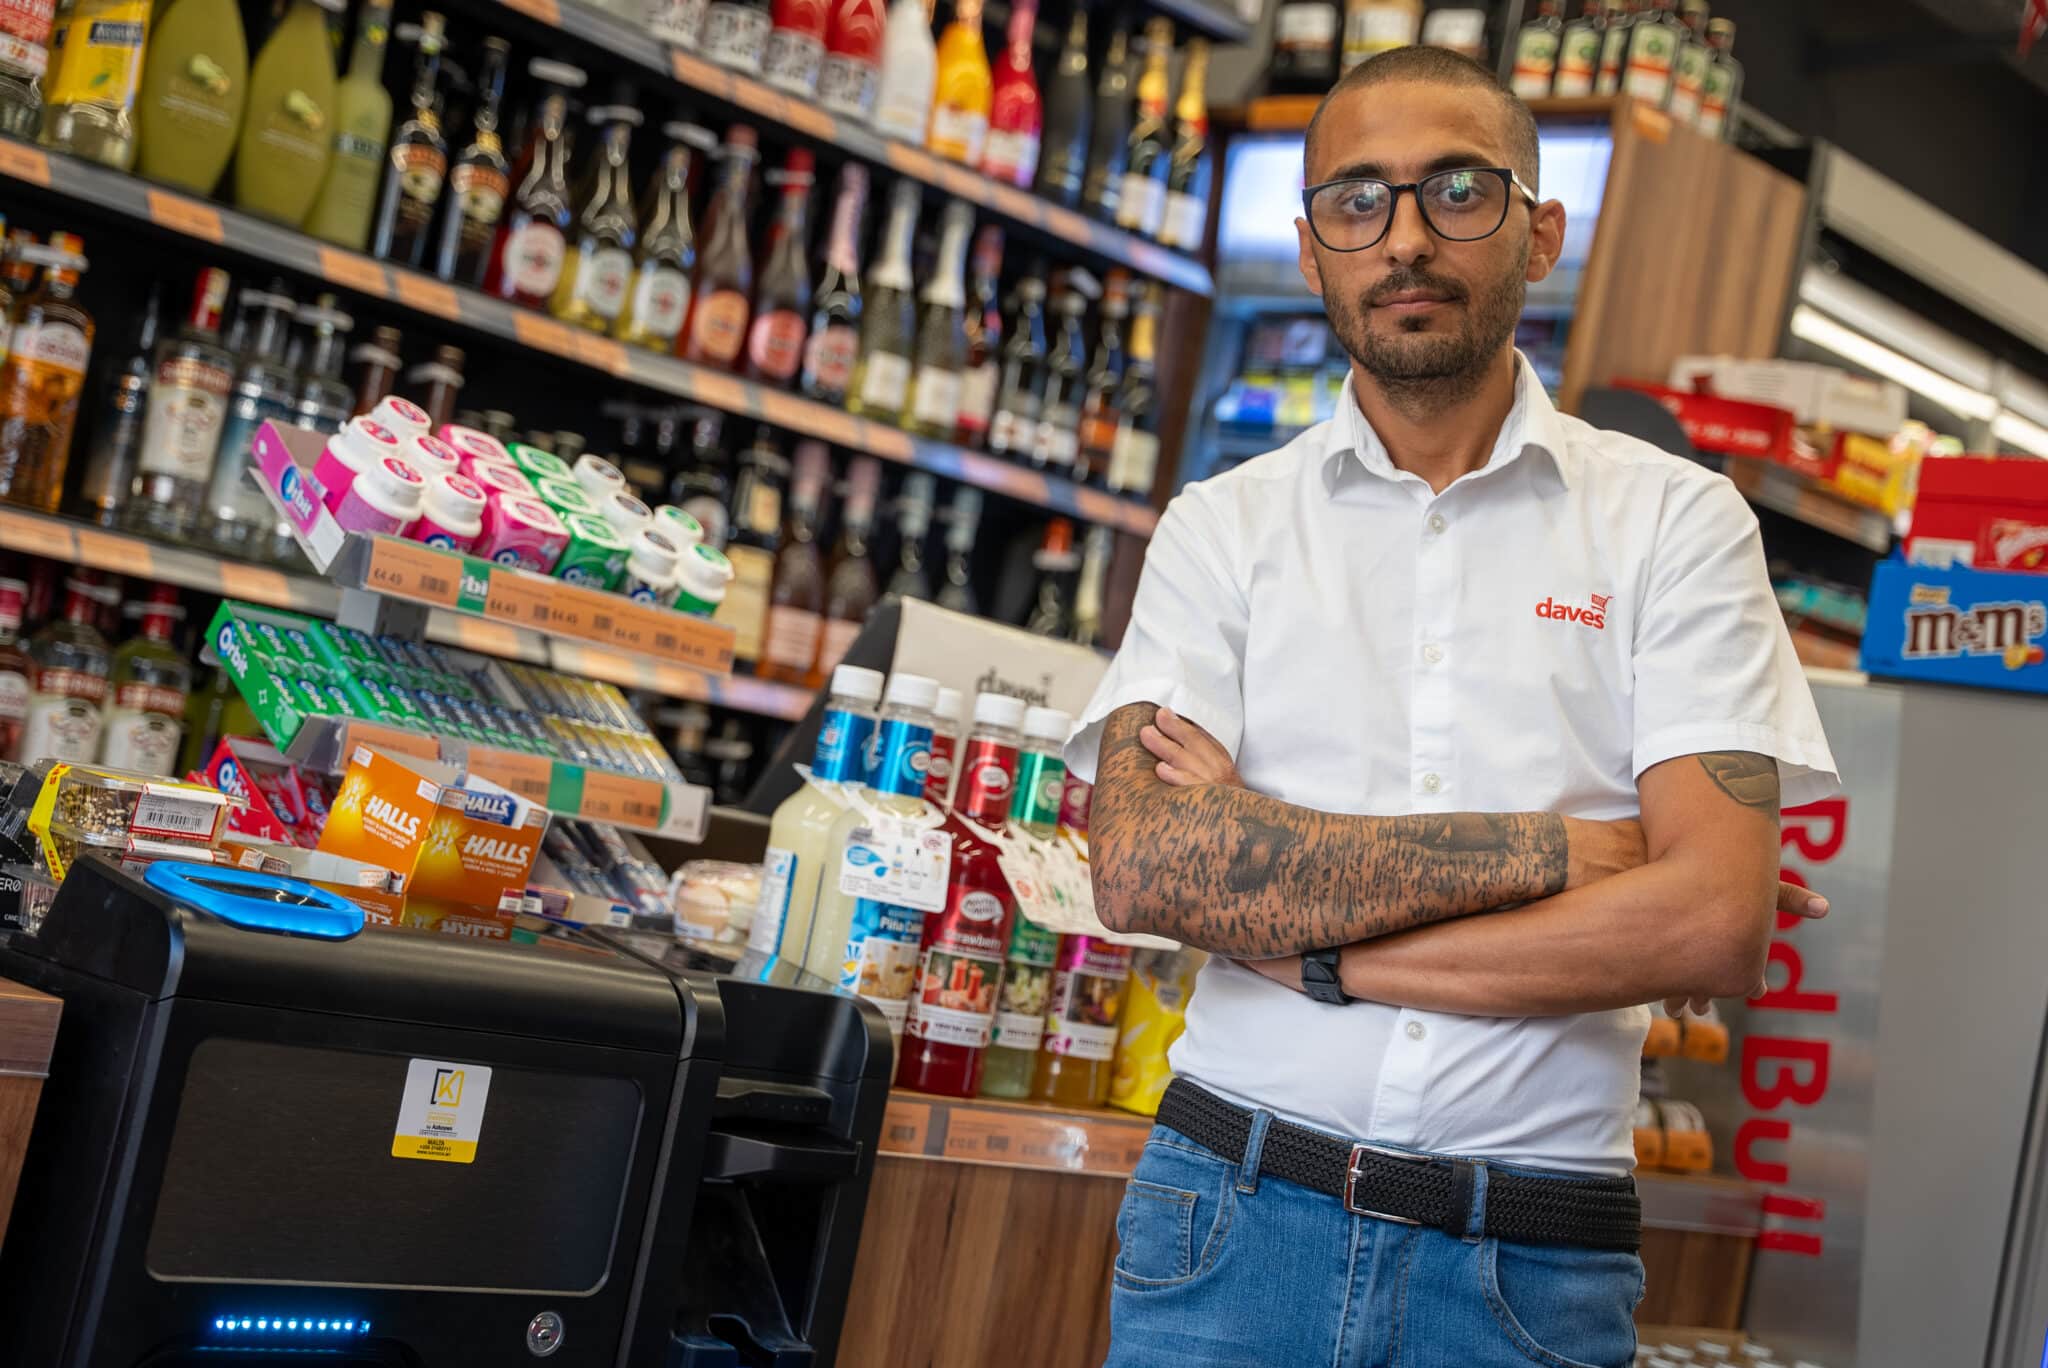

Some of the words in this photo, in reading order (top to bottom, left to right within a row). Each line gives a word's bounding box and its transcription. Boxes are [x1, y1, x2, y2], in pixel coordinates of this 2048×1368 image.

[283, 467, 313, 518] Orbit
[1536, 597, 1604, 629] daves
[218, 624, 248, 679] Orbit
[365, 795, 420, 840] HALLS
[465, 796, 510, 817] HALLS
[464, 834, 530, 868] HALLS
[1734, 1035, 1830, 1258] Bull
